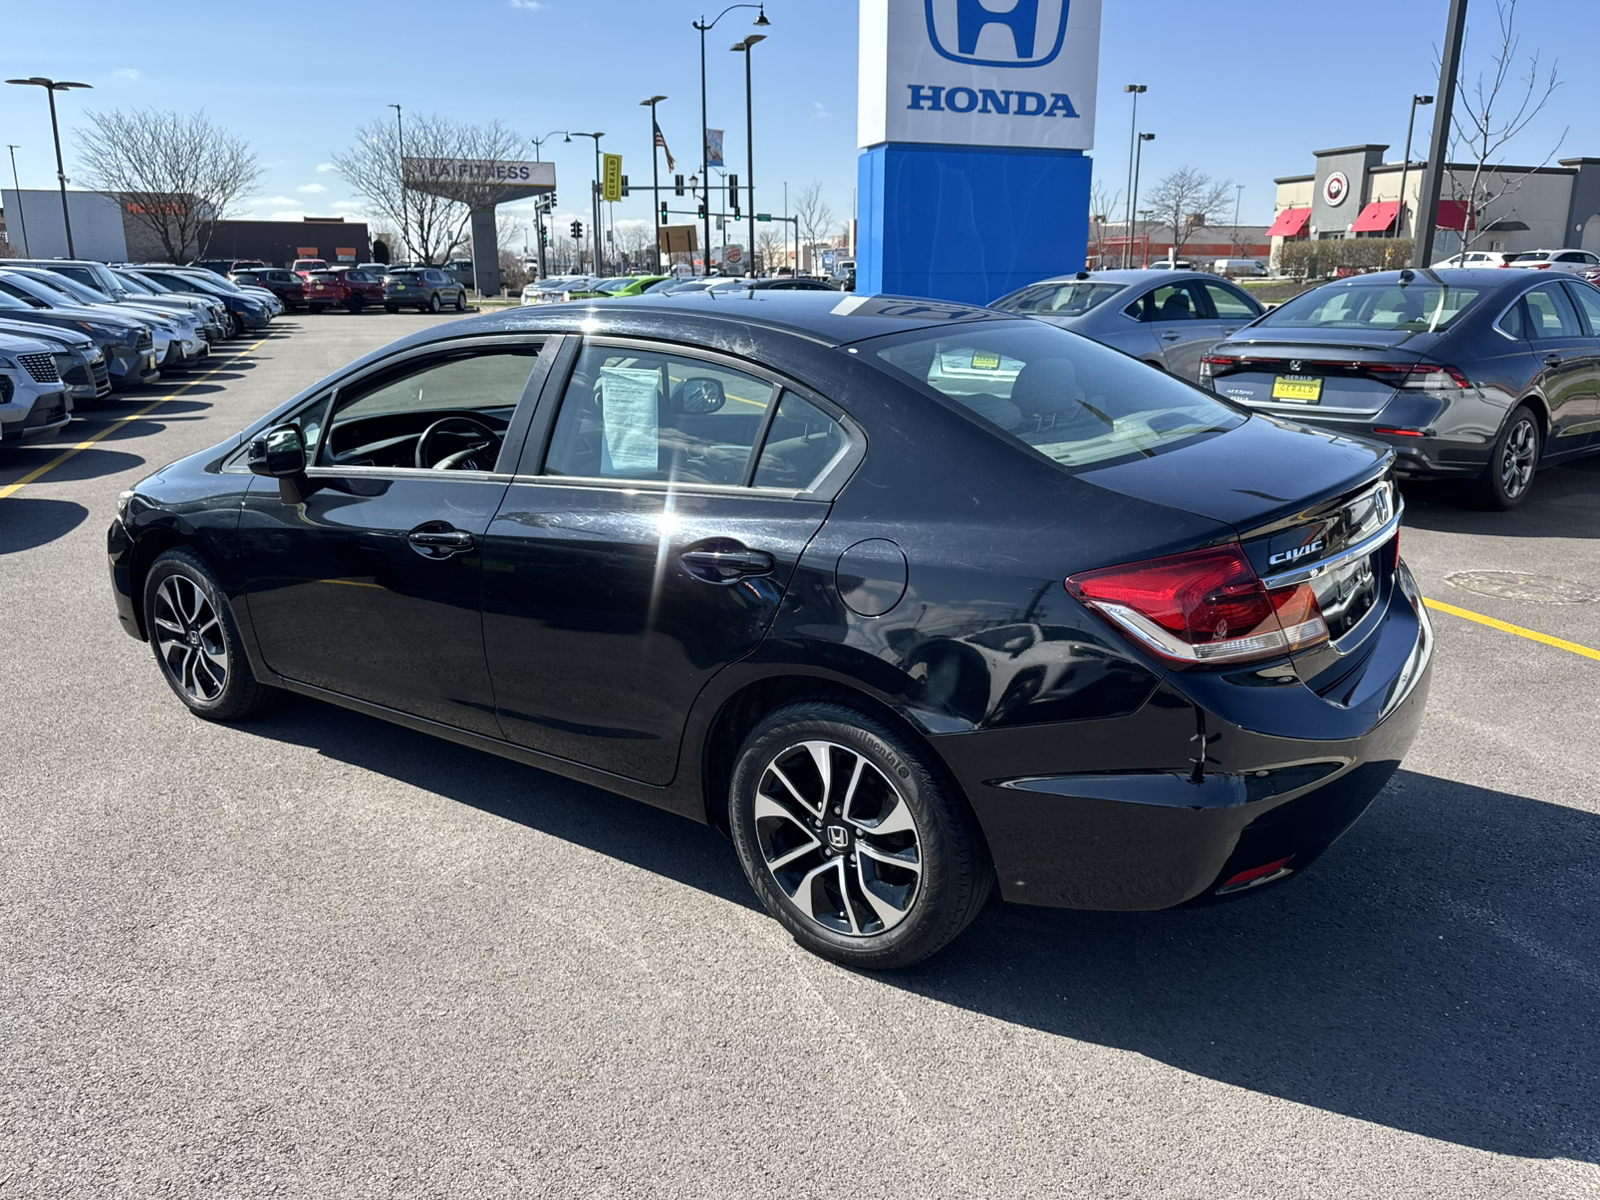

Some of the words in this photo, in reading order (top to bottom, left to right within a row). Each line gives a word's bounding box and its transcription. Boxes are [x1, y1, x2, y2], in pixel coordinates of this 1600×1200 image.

[907, 84, 1080, 118] HONDA
[1279, 384, 1314, 394] GERALD
[1269, 540, 1324, 565] CIVIC
